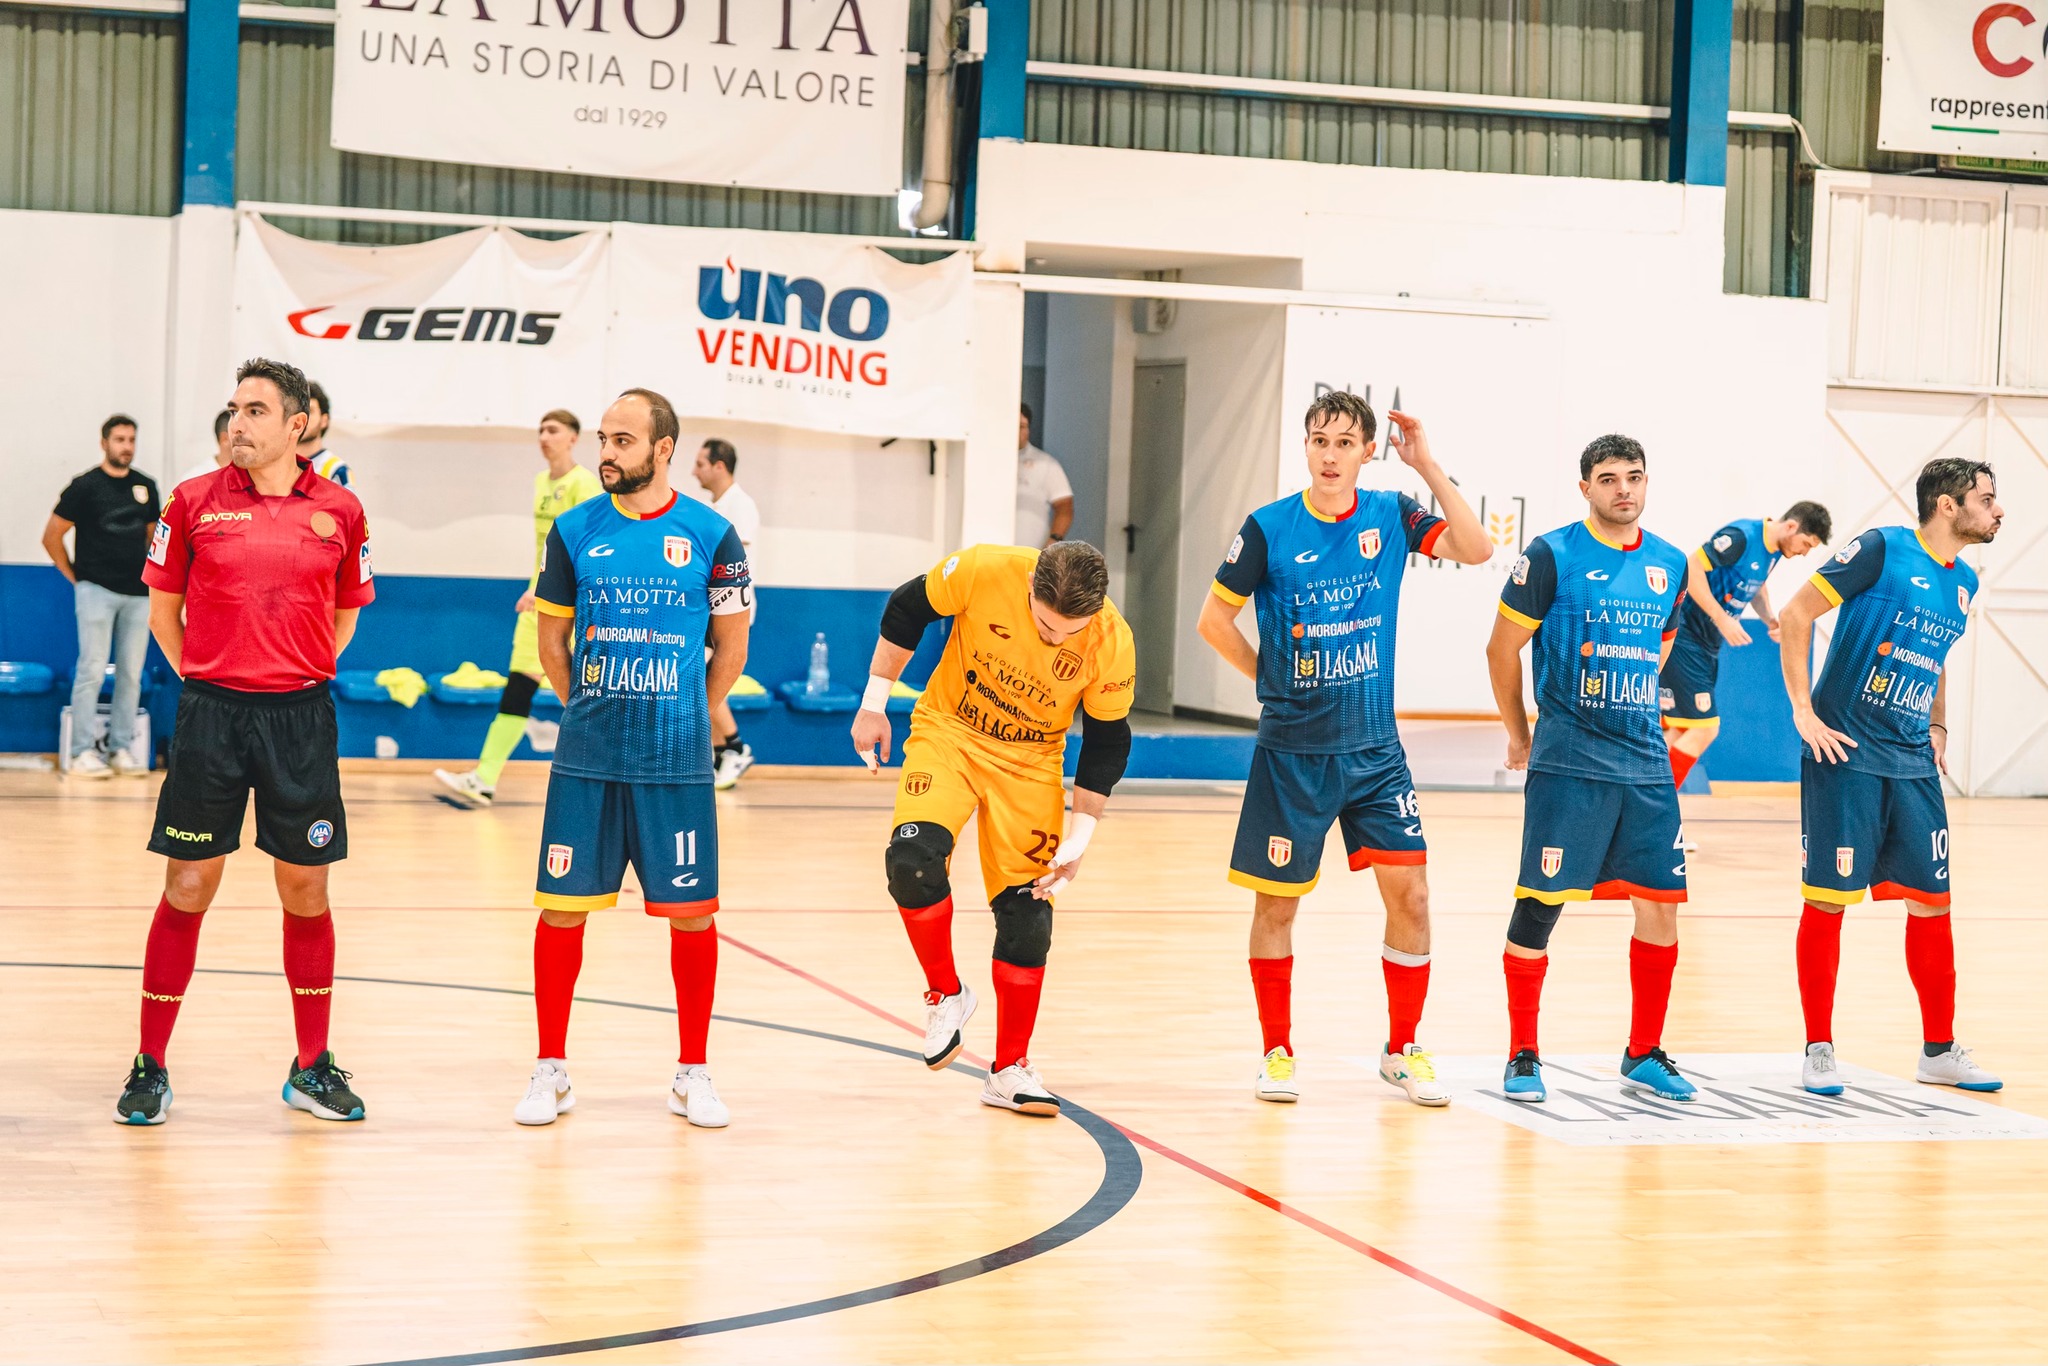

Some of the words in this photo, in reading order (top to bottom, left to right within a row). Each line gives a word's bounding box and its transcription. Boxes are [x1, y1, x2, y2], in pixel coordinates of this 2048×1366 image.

[1971, 2, 2048, 78] C
[360, 29, 449, 68] UNA
[472, 41, 625, 86] STORIA
[650, 59, 689, 93] DI
[713, 65, 875, 107] VALORE
[573, 104, 608, 124] dal
[617, 106, 668, 129] 1929
[1930, 96, 2048, 121] rappresen
[357, 307, 561, 346] GEMS
[697, 327, 888, 386] VENDING
[596, 576, 677, 586] GIOIELLERIA
[1294, 592, 1319, 606] LA
[1323, 576, 1382, 604] MOTTA
[1306, 570, 1374, 589] GIOIELLERIA
[588, 589, 609, 604] LA
[615, 588, 686, 607] MOTTA
[633, 607, 649, 615] 1929
[1600, 599, 1662, 611] GIOIELLERIA
[1585, 609, 1610, 623] LA
[1615, 610, 1665, 629] MOTTA
[1893, 610, 1919, 630] LA
[1920, 619, 1960, 644] MOTT
[1914, 605, 1964, 631] GIOIELLERIA
[1324, 631, 1379, 680] LAGANÀ
[608, 651, 679, 692] LAGANÀ
[986, 652, 1052, 694] GIOIELLERIA
[1293, 680, 1319, 688] 1968
[582, 689, 602, 697] 1968
[995, 668, 1057, 709] MOTTA
[1861, 693, 1886, 707] 1968
[1580, 699, 1605, 709] 1968
[1395, 789, 1420, 818] 16
[166, 826, 212, 842] GIVOVA
[674, 829, 696, 866] 11
[1023, 829, 1060, 866] 23
[1930, 828, 1948, 861] 10
